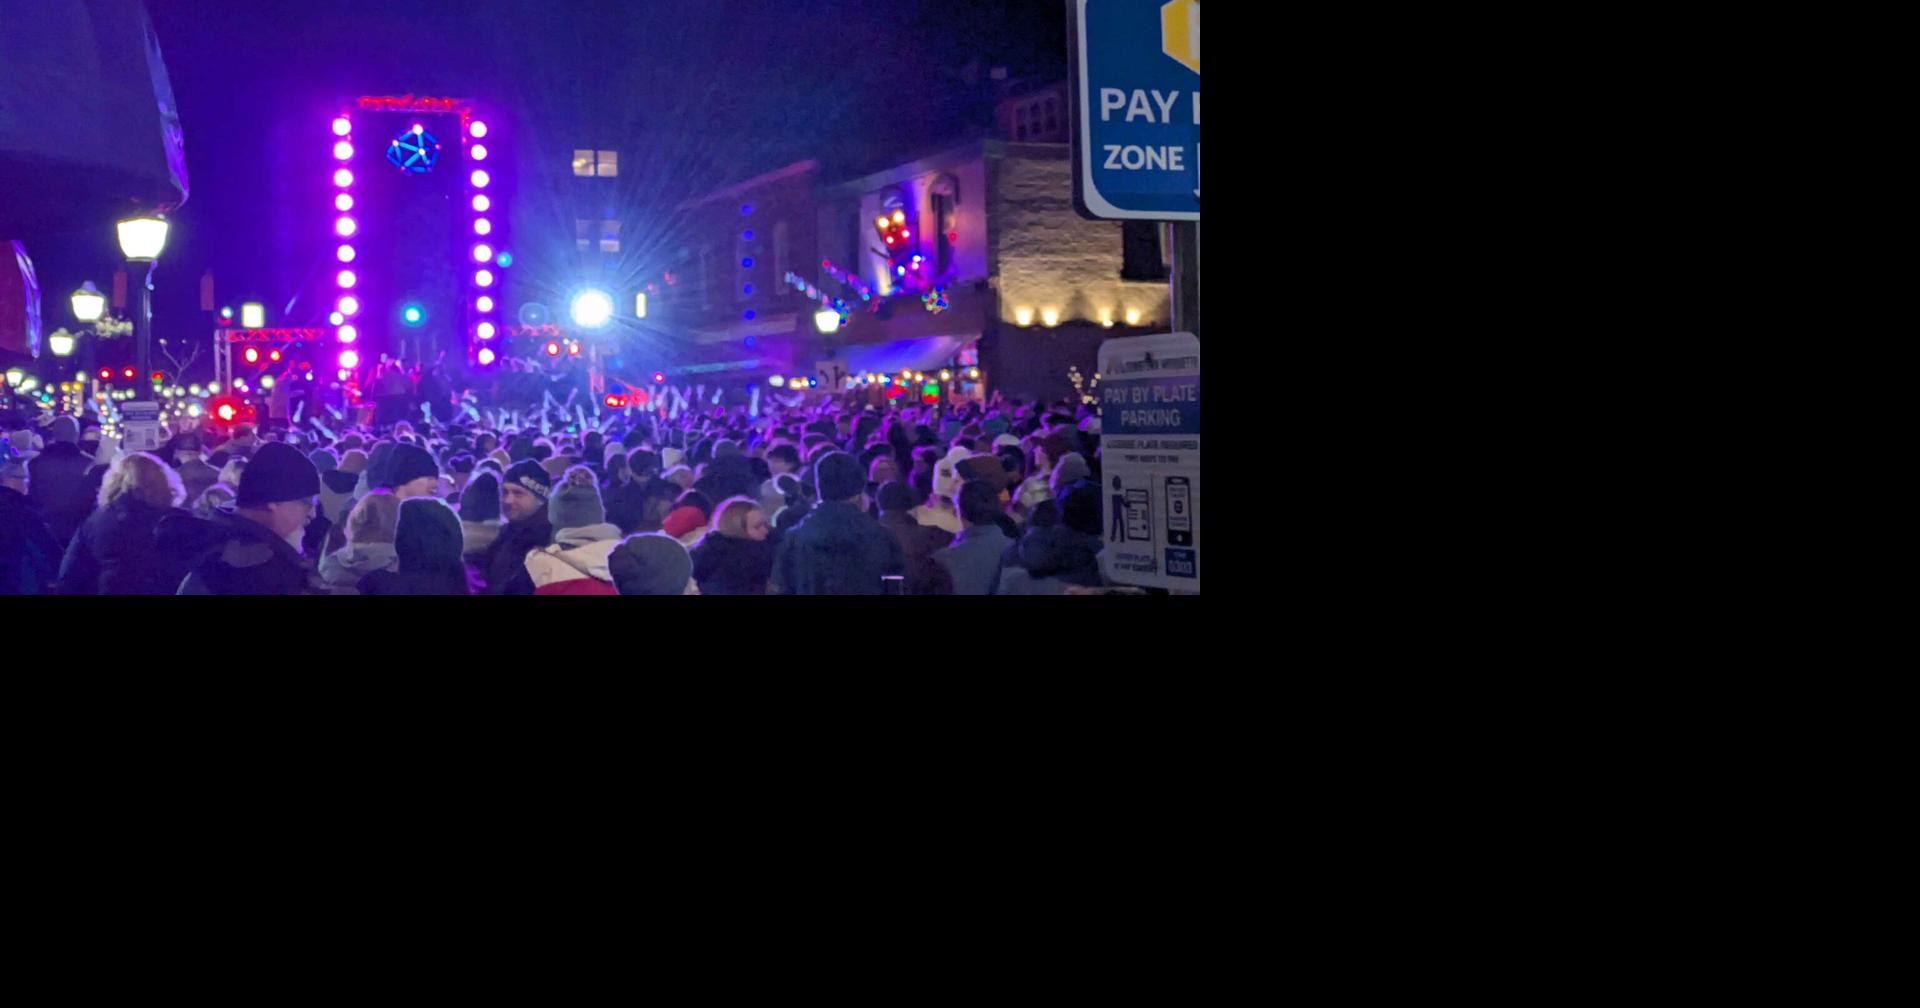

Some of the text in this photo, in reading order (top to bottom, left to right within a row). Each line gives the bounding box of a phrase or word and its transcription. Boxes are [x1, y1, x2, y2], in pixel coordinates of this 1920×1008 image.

[1101, 88, 1179, 124] PAY
[1103, 145, 1184, 171] ZONE
[1104, 385, 1196, 404] PAY BY PLATE
[1121, 409, 1181, 427] PARKING
